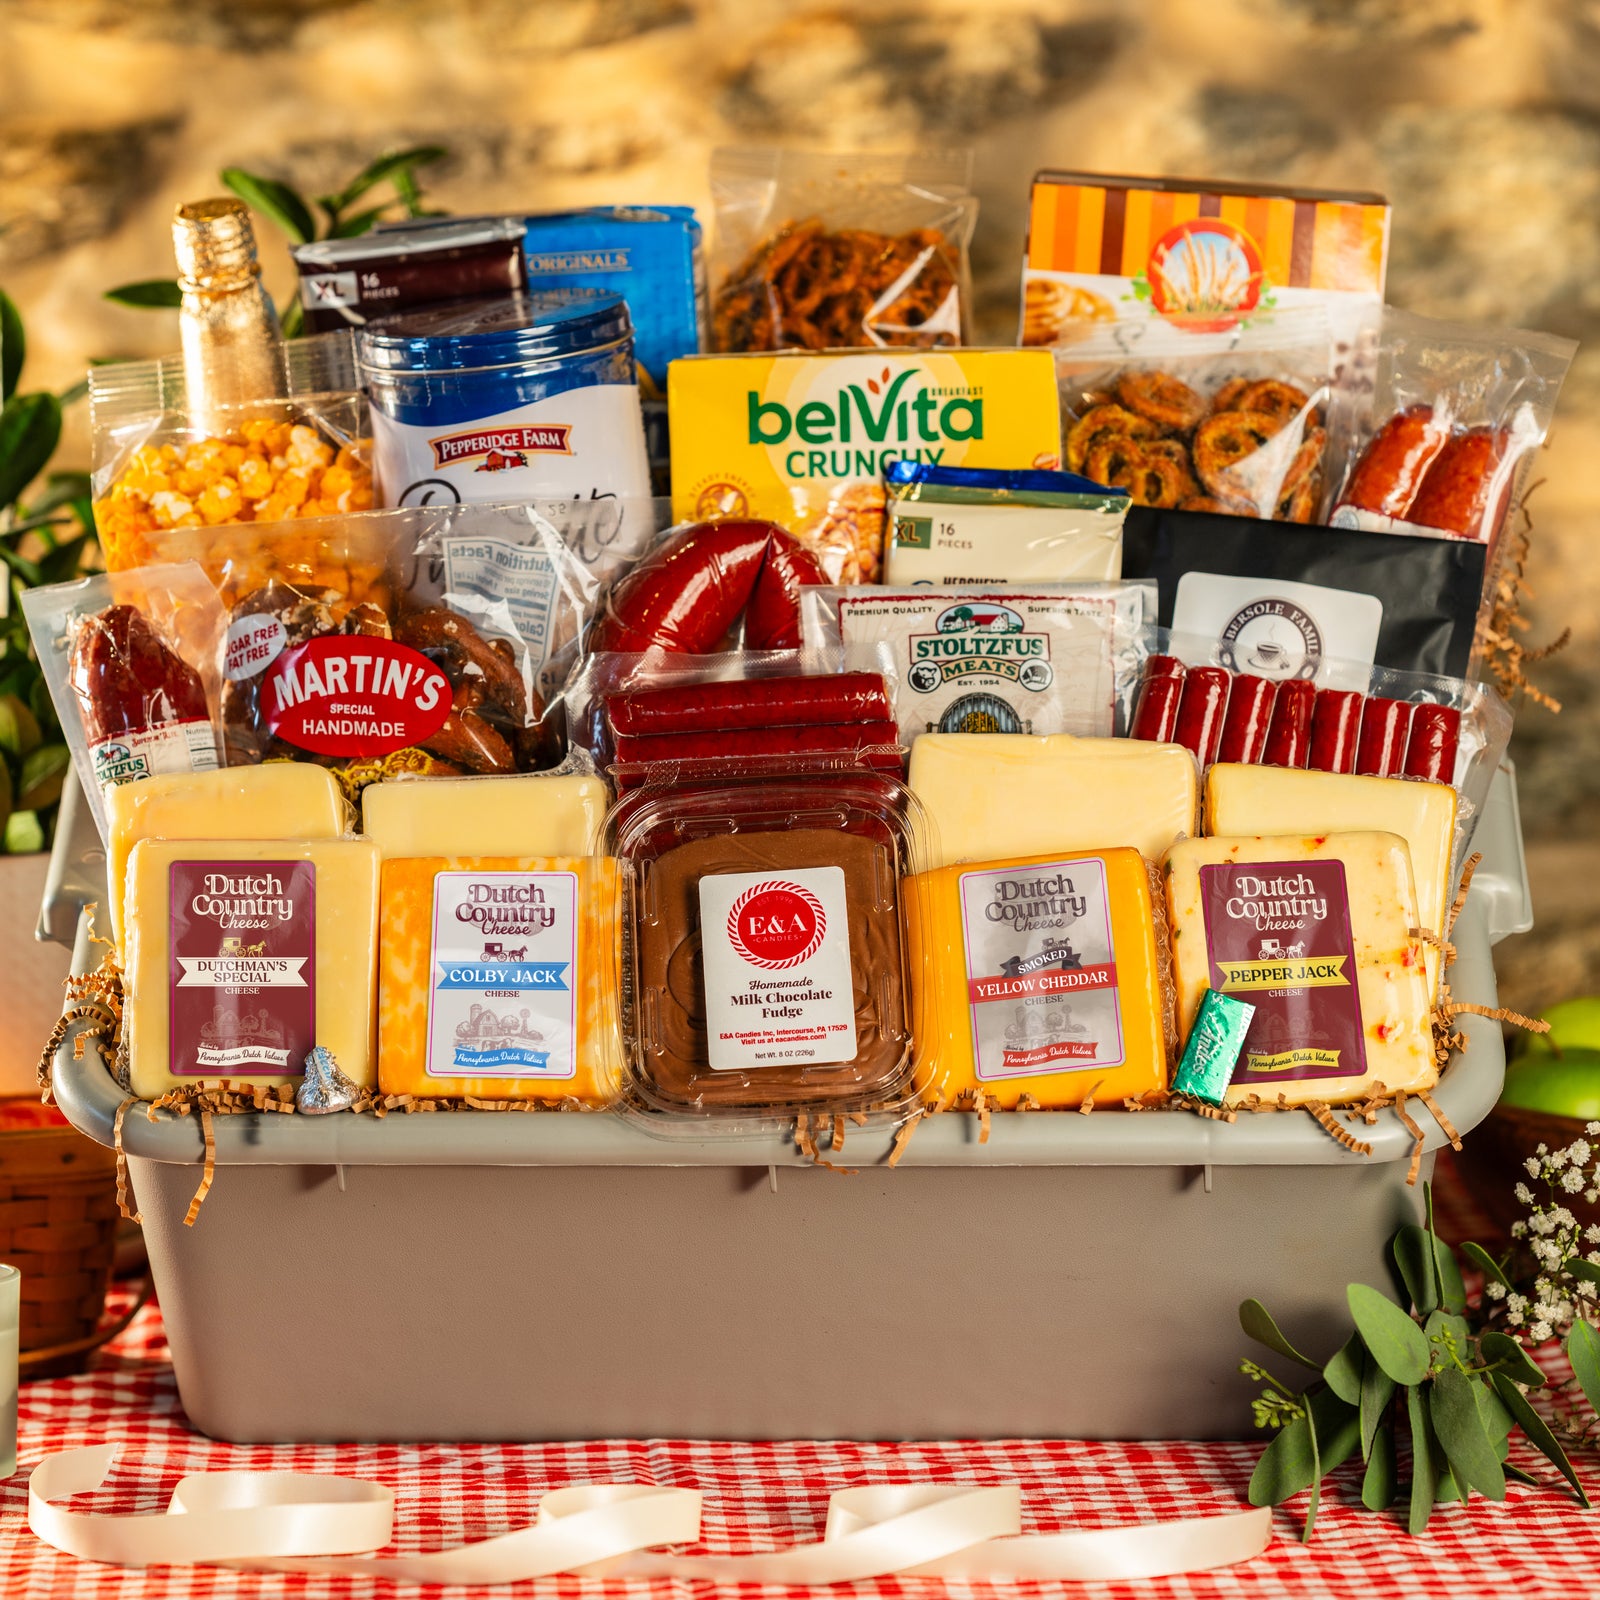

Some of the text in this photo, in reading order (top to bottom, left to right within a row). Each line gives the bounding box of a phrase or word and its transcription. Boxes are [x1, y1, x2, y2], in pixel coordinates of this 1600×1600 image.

[529, 253, 628, 272] ORIGINALS
[361, 272, 380, 288] 16
[310, 279, 346, 301] XL
[362, 286, 400, 299] PIECES
[930, 385, 984, 397] BREAKFAST
[748, 369, 984, 445] belVita
[441, 429, 561, 460] PEPPERIDGE FARM
[895, 521, 921, 543] XL
[940, 523, 955, 536] 16
[938, 539, 974, 549] PIECES
[847, 607, 890, 617] PREMIUM
[254, 623, 279, 643] FREE
[1222, 603, 1320, 658] BERSOLE FAMIL
[228, 642, 270, 672] FAT FREE
[917, 638, 1043, 658] STOLTZFUS
[943, 656, 1017, 679] MEATS
[273, 655, 446, 712] MARTIN'S
[330, 703, 376, 716] SPECIAL
[302, 719, 406, 738] HANDMADE
[204, 873, 283, 895] Dutch
[995, 874, 1075, 901] Dutch
[1235, 874, 1316, 898] Dutch
[468, 883, 545, 904] Dutch
[192, 894, 293, 921] Country
[455, 903, 555, 927] Country
[985, 896, 1086, 922] Country
[1226, 896, 1328, 920] Country
[219, 911, 270, 929] Cheese
[482, 918, 531, 936] Cheese
[749, 912, 808, 936] E&A
[1014, 916, 1064, 932] Cheese
[1255, 914, 1305, 931] Cheese
[755, 935, 799, 943] CANDIES
[198, 961, 288, 972] DUTCHMAN'S
[1018, 949, 1067, 974] SMOKED
[214, 973, 271, 983] SPECIAL
[450, 969, 557, 984] COLBY JACK
[749, 976, 814, 990] Homemade
[1230, 965, 1338, 983] PEPPER JACK
[224, 987, 260, 995] CHEESE
[977, 971, 1108, 997] YELLOW CHEDDAR
[1269, 988, 1303, 998] CHEESE
[485, 990, 520, 998] CHEESE
[731, 988, 833, 1006] Milk Chocolate
[1025, 995, 1064, 1006] CHEESE
[762, 1005, 803, 1019] Fudge
[720, 1032, 733, 1040] E&A
[735, 1030, 761, 1038] Candies
[776, 1026, 816, 1036] Intercourse,
[827, 1024, 848, 1032] 17529
[741, 1038, 756, 1046] Visit
[200, 1049, 285, 1064] Pennsylvania Dutch Values
[457, 1051, 544, 1065] Pennsylvania Dutch Values
[795, 1048, 815, 1057] (226g)
[1006, 1045, 1092, 1065] Pennsylvania Dutch Values
[1251, 1052, 1336, 1070] Pennsylvania Dutch Values
